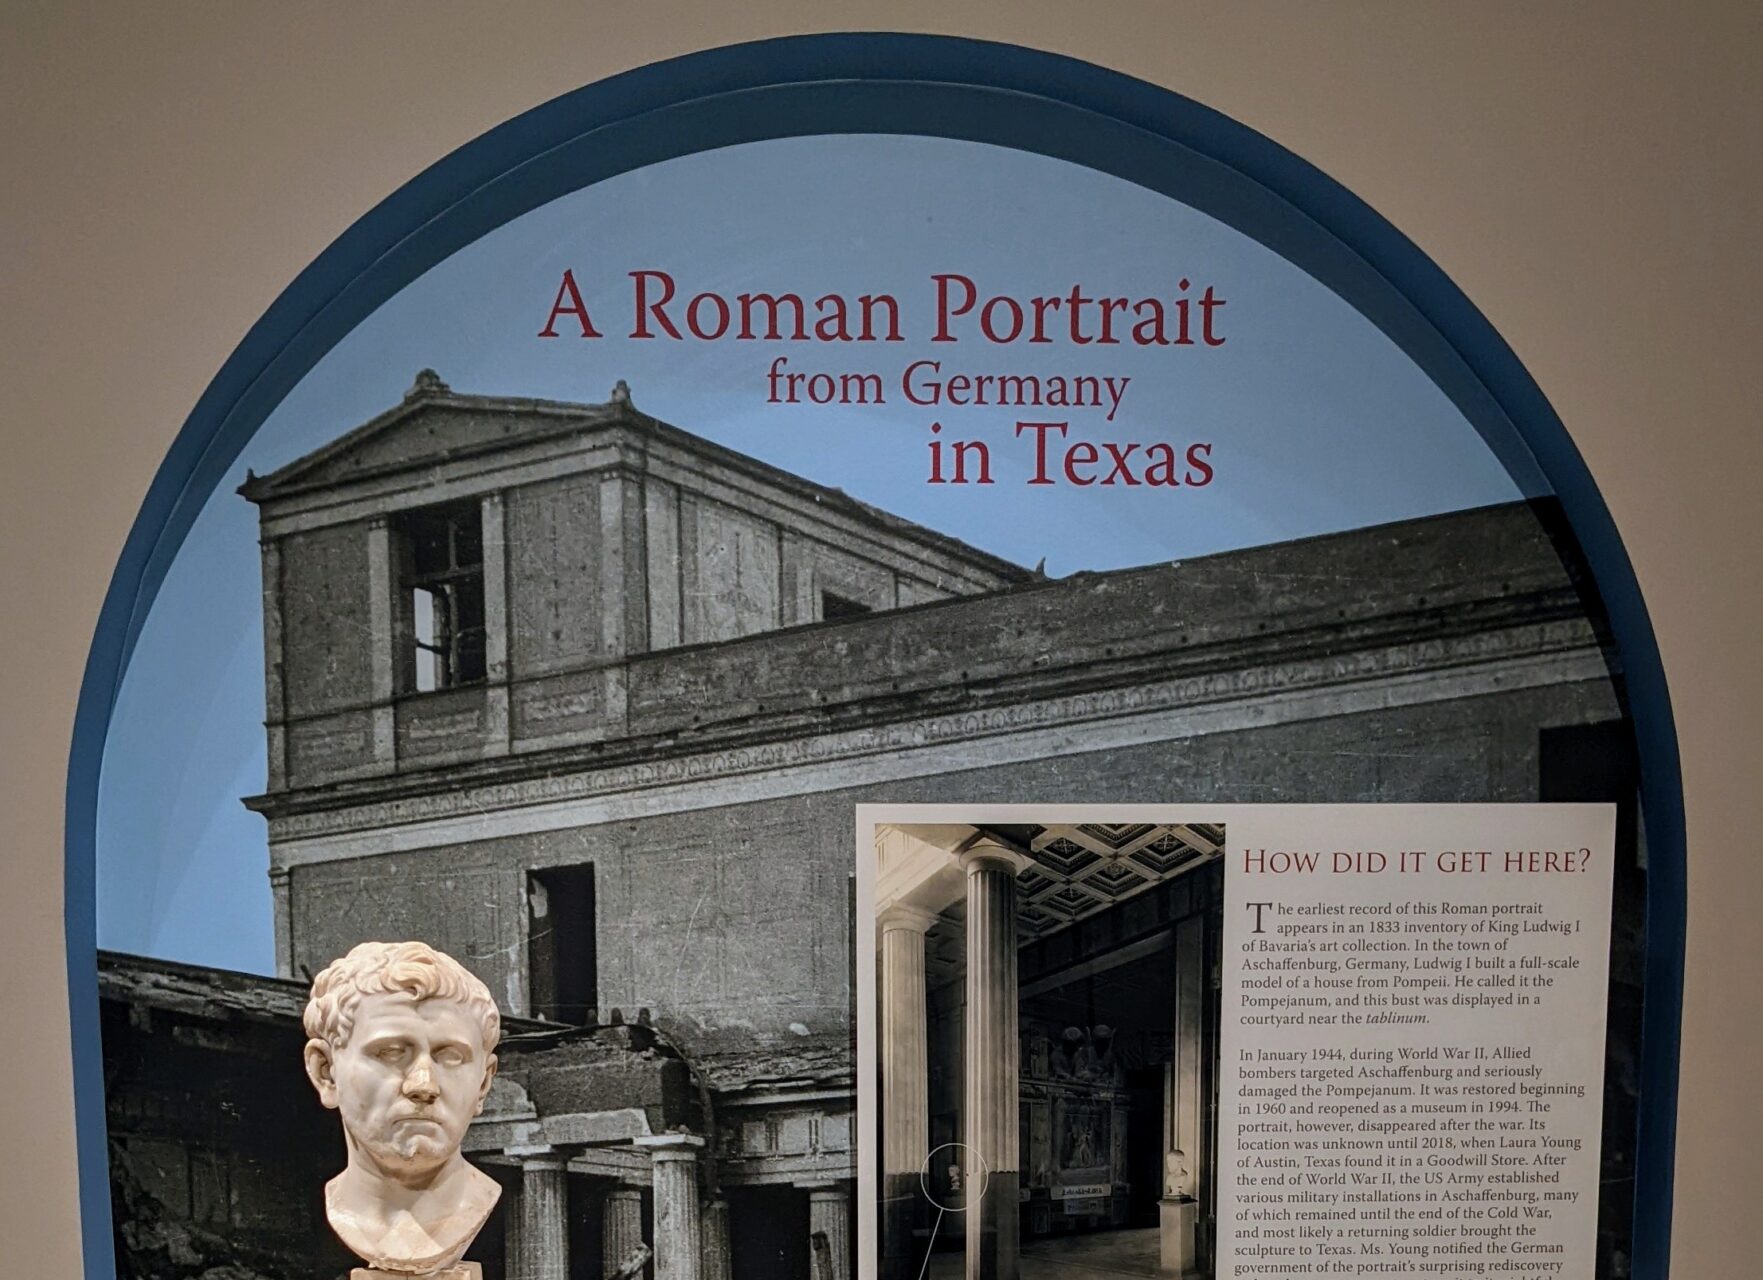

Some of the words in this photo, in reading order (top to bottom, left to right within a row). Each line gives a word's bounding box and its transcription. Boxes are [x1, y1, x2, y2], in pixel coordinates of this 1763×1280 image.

[538, 269, 603, 337] A
[628, 271, 905, 341] Roman
[931, 275, 1226, 346] Portrait
[767, 357, 885, 404] from
[903, 361, 1131, 420] Germany
[927, 423, 995, 485] in
[1015, 422, 1213, 486] Texas
[1244, 850, 1320, 873] HOW
[1333, 852, 1386, 873] DID
[1400, 852, 1426, 872] IT
[1438, 852, 1492, 872] GET
[1504, 848, 1591, 872] HERE?
[1246, 902, 1293, 934] The
[1298, 903, 1344, 914] earliest
[1350, 902, 1391, 914] record
[1396, 902, 1410, 914] of
[1414, 902, 1437, 914] this
[1442, 903, 1487, 914] Roman
[1492, 902, 1542, 917] portrait
[1277, 922, 1328, 936] appears
[1333, 922, 1344, 933] in
[1349, 925, 1364, 933] an
[1370, 922, 1400, 933] 1833
[1405, 922, 1467, 936] inventory
[1471, 920, 1485, 932] of
[1489, 920, 1518, 936] King
[1524, 920, 1571, 935] Ludwig
[1576, 920, 1580, 932] I
[1242, 940, 1256, 951] of
[1260, 940, 1315, 951] Bavaria's
[1320, 942, 1337, 951] art
[1342, 939, 1410, 951] collection.
[1416, 939, 1428, 951] In
[1433, 938, 1453, 951] the
[1458, 941, 1489, 950] town
[1494, 938, 1508, 950] of
[1242, 958, 1340, 973] Aschaffenburg,
[1346, 958, 1409, 972] Germany,
[1414, 957, 1462, 972] Ludwig
[1466, 957, 1471, 969] I
[1476, 956, 1504, 968] built
[1509, 960, 1516, 968] a
[1520, 956, 1579, 968] full-scale
[1242, 976, 1281, 988] model
[1286, 976, 1300, 988] of
[1315, 976, 1352, 988] house
[1357, 976, 1388, 987] from
[1394, 976, 1449, 990] Pompeii.
[1455, 976, 1473, 987] He
[1477, 974, 1515, 987] called
[1520, 975, 1529, 986] it
[1533, 974, 1553, 986] the
[1242, 995, 1331, 1009] Pompejanum,
[1336, 994, 1358, 1006] and
[1364, 994, 1387, 1006] this
[1392, 994, 1419, 1005] bust
[1424, 997, 1448, 1005] was
[1452, 993, 1512, 1008] displayed
[1518, 994, 1529, 1004] in
[1240, 1012, 1304, 1028] courtyard
[1308, 1016, 1337, 1024] near
[1342, 1012, 1362, 1024] the
[1366, 1012, 1429, 1024] tablinum.
[1240, 1050, 1252, 1060] In
[1258, 1049, 1307, 1064] January
[1313, 1049, 1345, 1062] 1944,
[1350, 1048, 1393, 1063] during
[1398, 1047, 1437, 1059] World
[1443, 1048, 1470, 1059] War
[1475, 1048, 1488, 1061] II,
[1492, 1046, 1530, 1058] Allied
